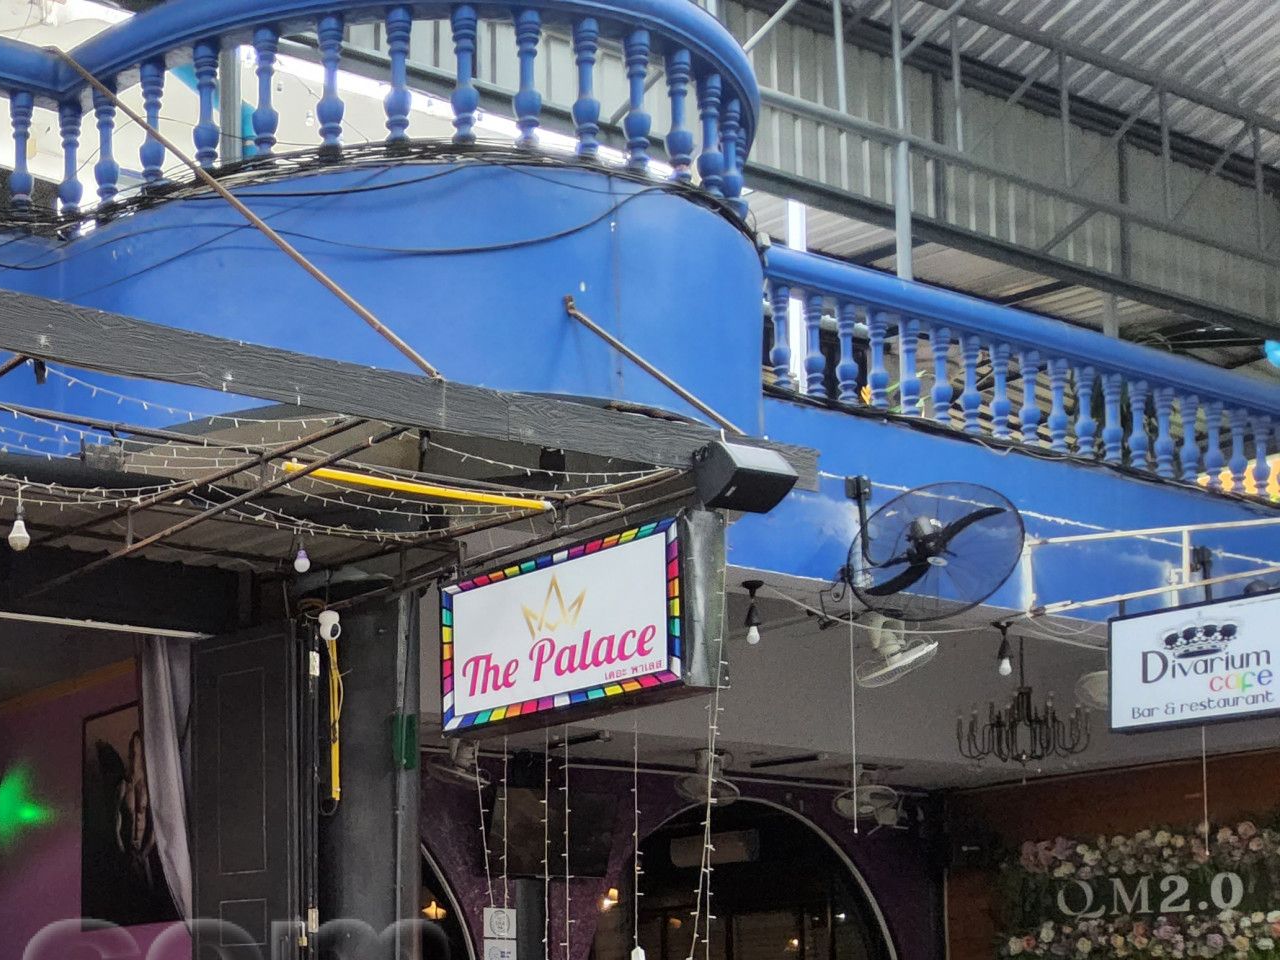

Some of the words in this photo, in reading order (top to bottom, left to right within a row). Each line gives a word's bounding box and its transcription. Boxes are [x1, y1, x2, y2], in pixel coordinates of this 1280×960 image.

[462, 653, 519, 697] The
[528, 624, 657, 682] Palace
[1141, 649, 1271, 684] Divarium
[1209, 668, 1274, 693] cafe
[1131, 706, 1160, 720] Bar
[1164, 703, 1175, 716] &
[1180, 690, 1275, 714] restaurant
